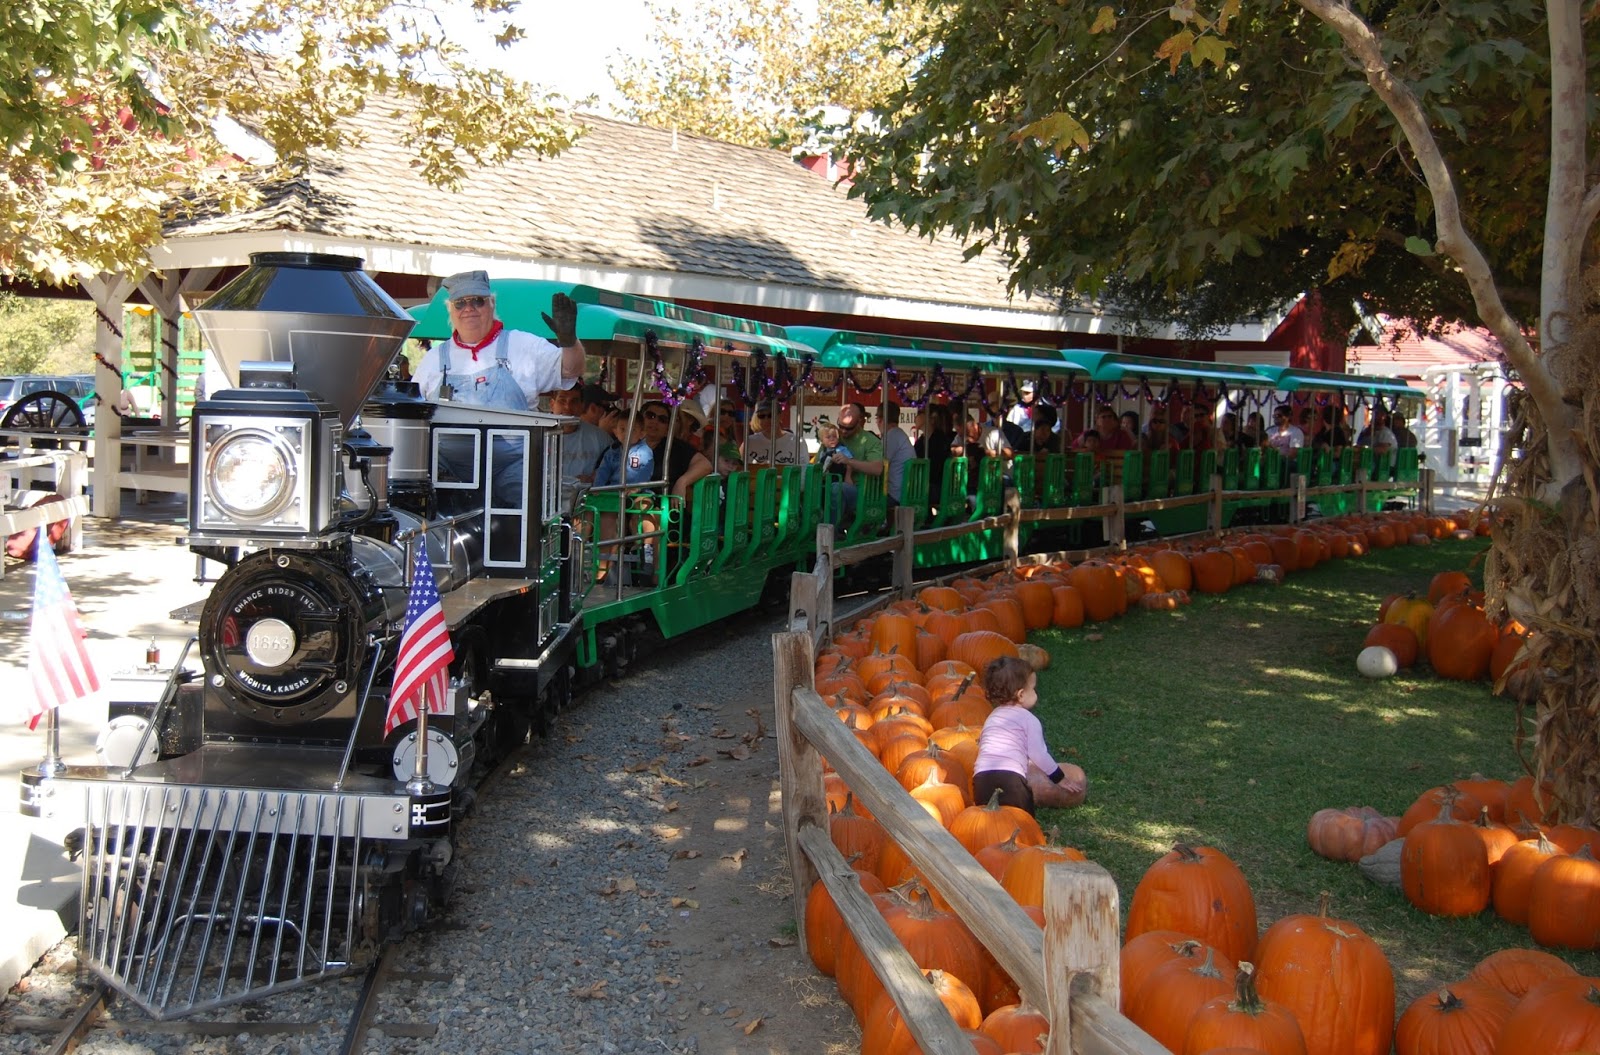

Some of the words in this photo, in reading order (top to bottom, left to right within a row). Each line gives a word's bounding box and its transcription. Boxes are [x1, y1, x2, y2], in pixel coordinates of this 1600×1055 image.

[631, 456, 639, 469] B
[234, 590, 263, 613] CHANCE
[267, 587, 295, 597] RIDES
[253, 635, 290, 651] 1863
[277, 677, 310, 693] KANSAS
